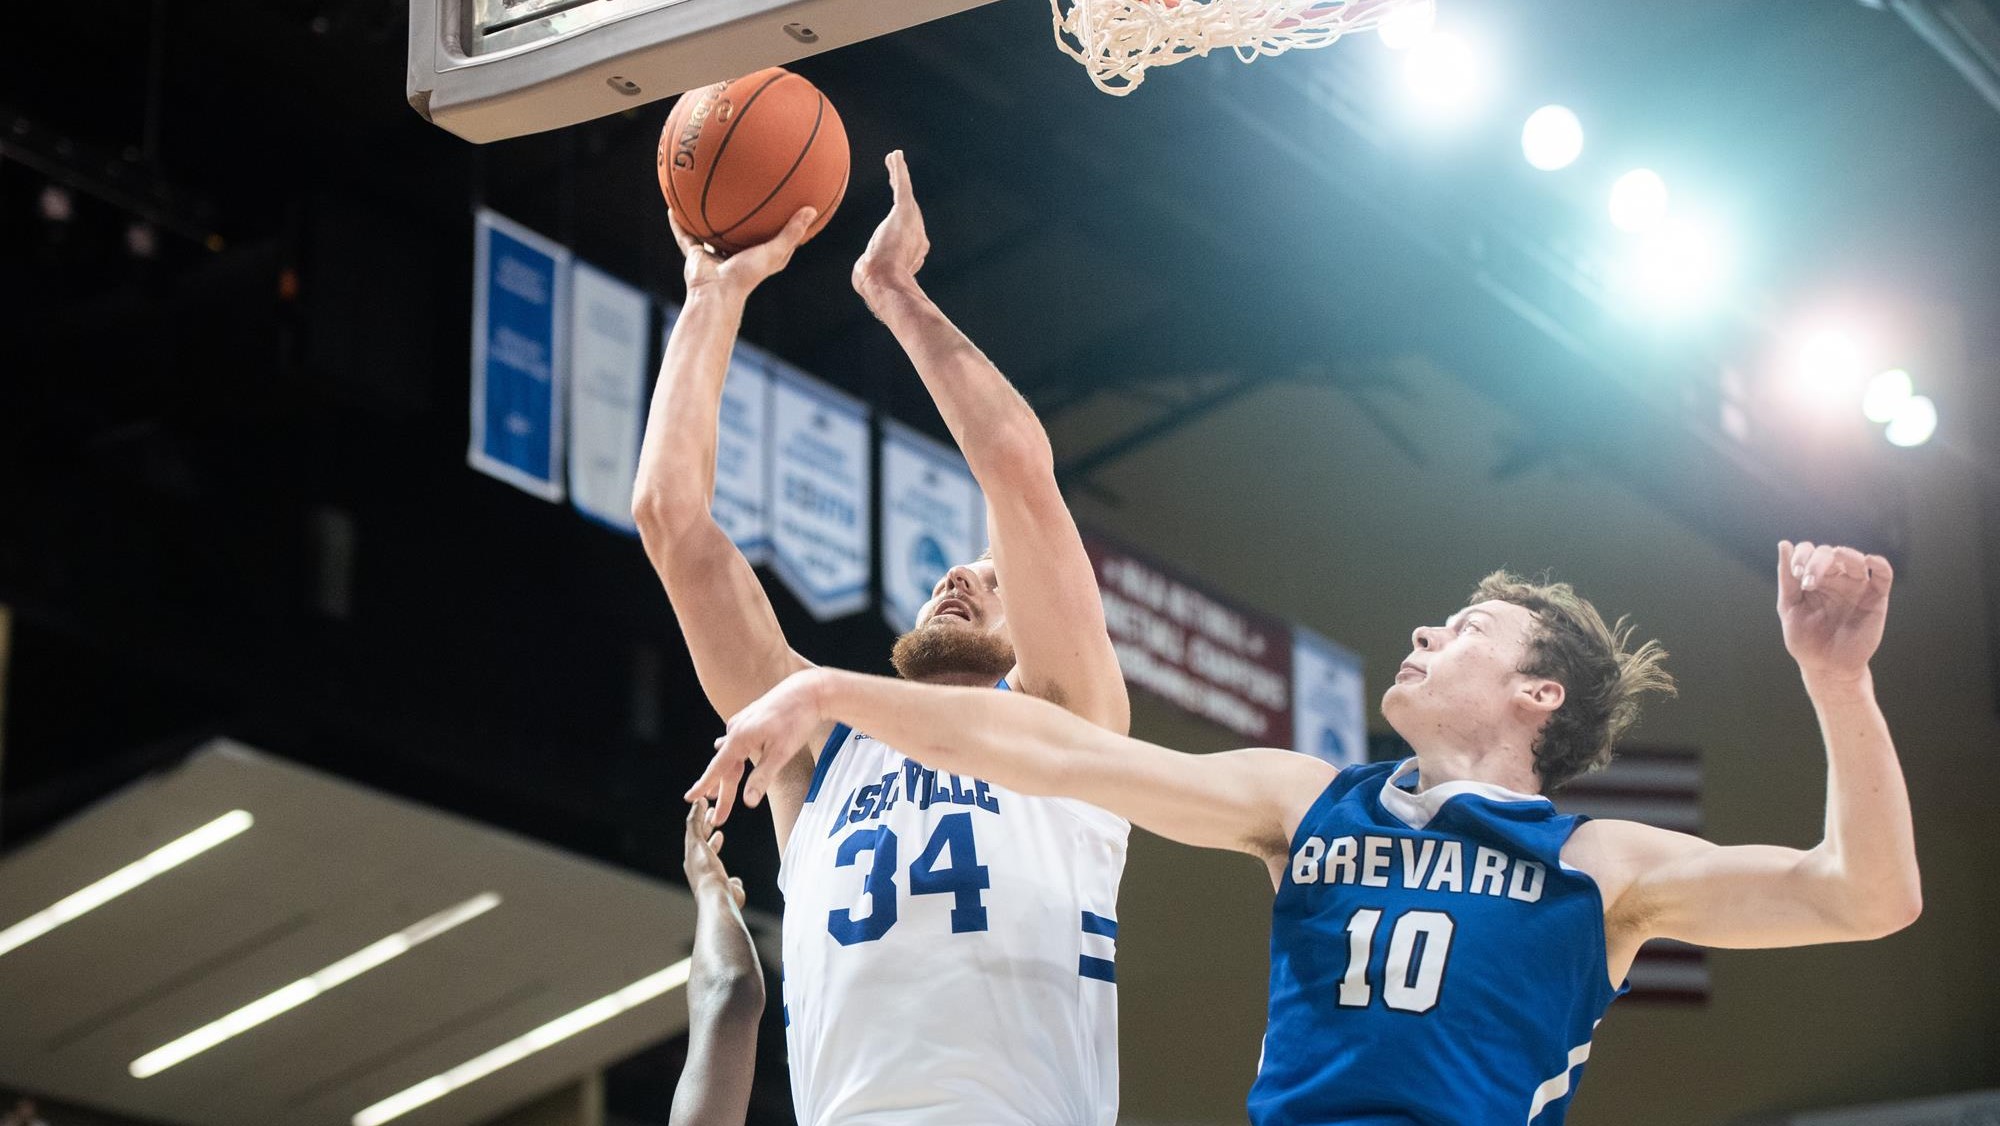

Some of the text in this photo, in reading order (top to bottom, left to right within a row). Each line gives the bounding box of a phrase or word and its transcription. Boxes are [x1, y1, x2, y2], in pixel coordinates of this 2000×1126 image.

[828, 757, 1001, 838] ASHVILLE
[827, 812, 990, 946] 34
[1291, 835, 1546, 904] BREVARD
[1337, 908, 1455, 1014] 10
